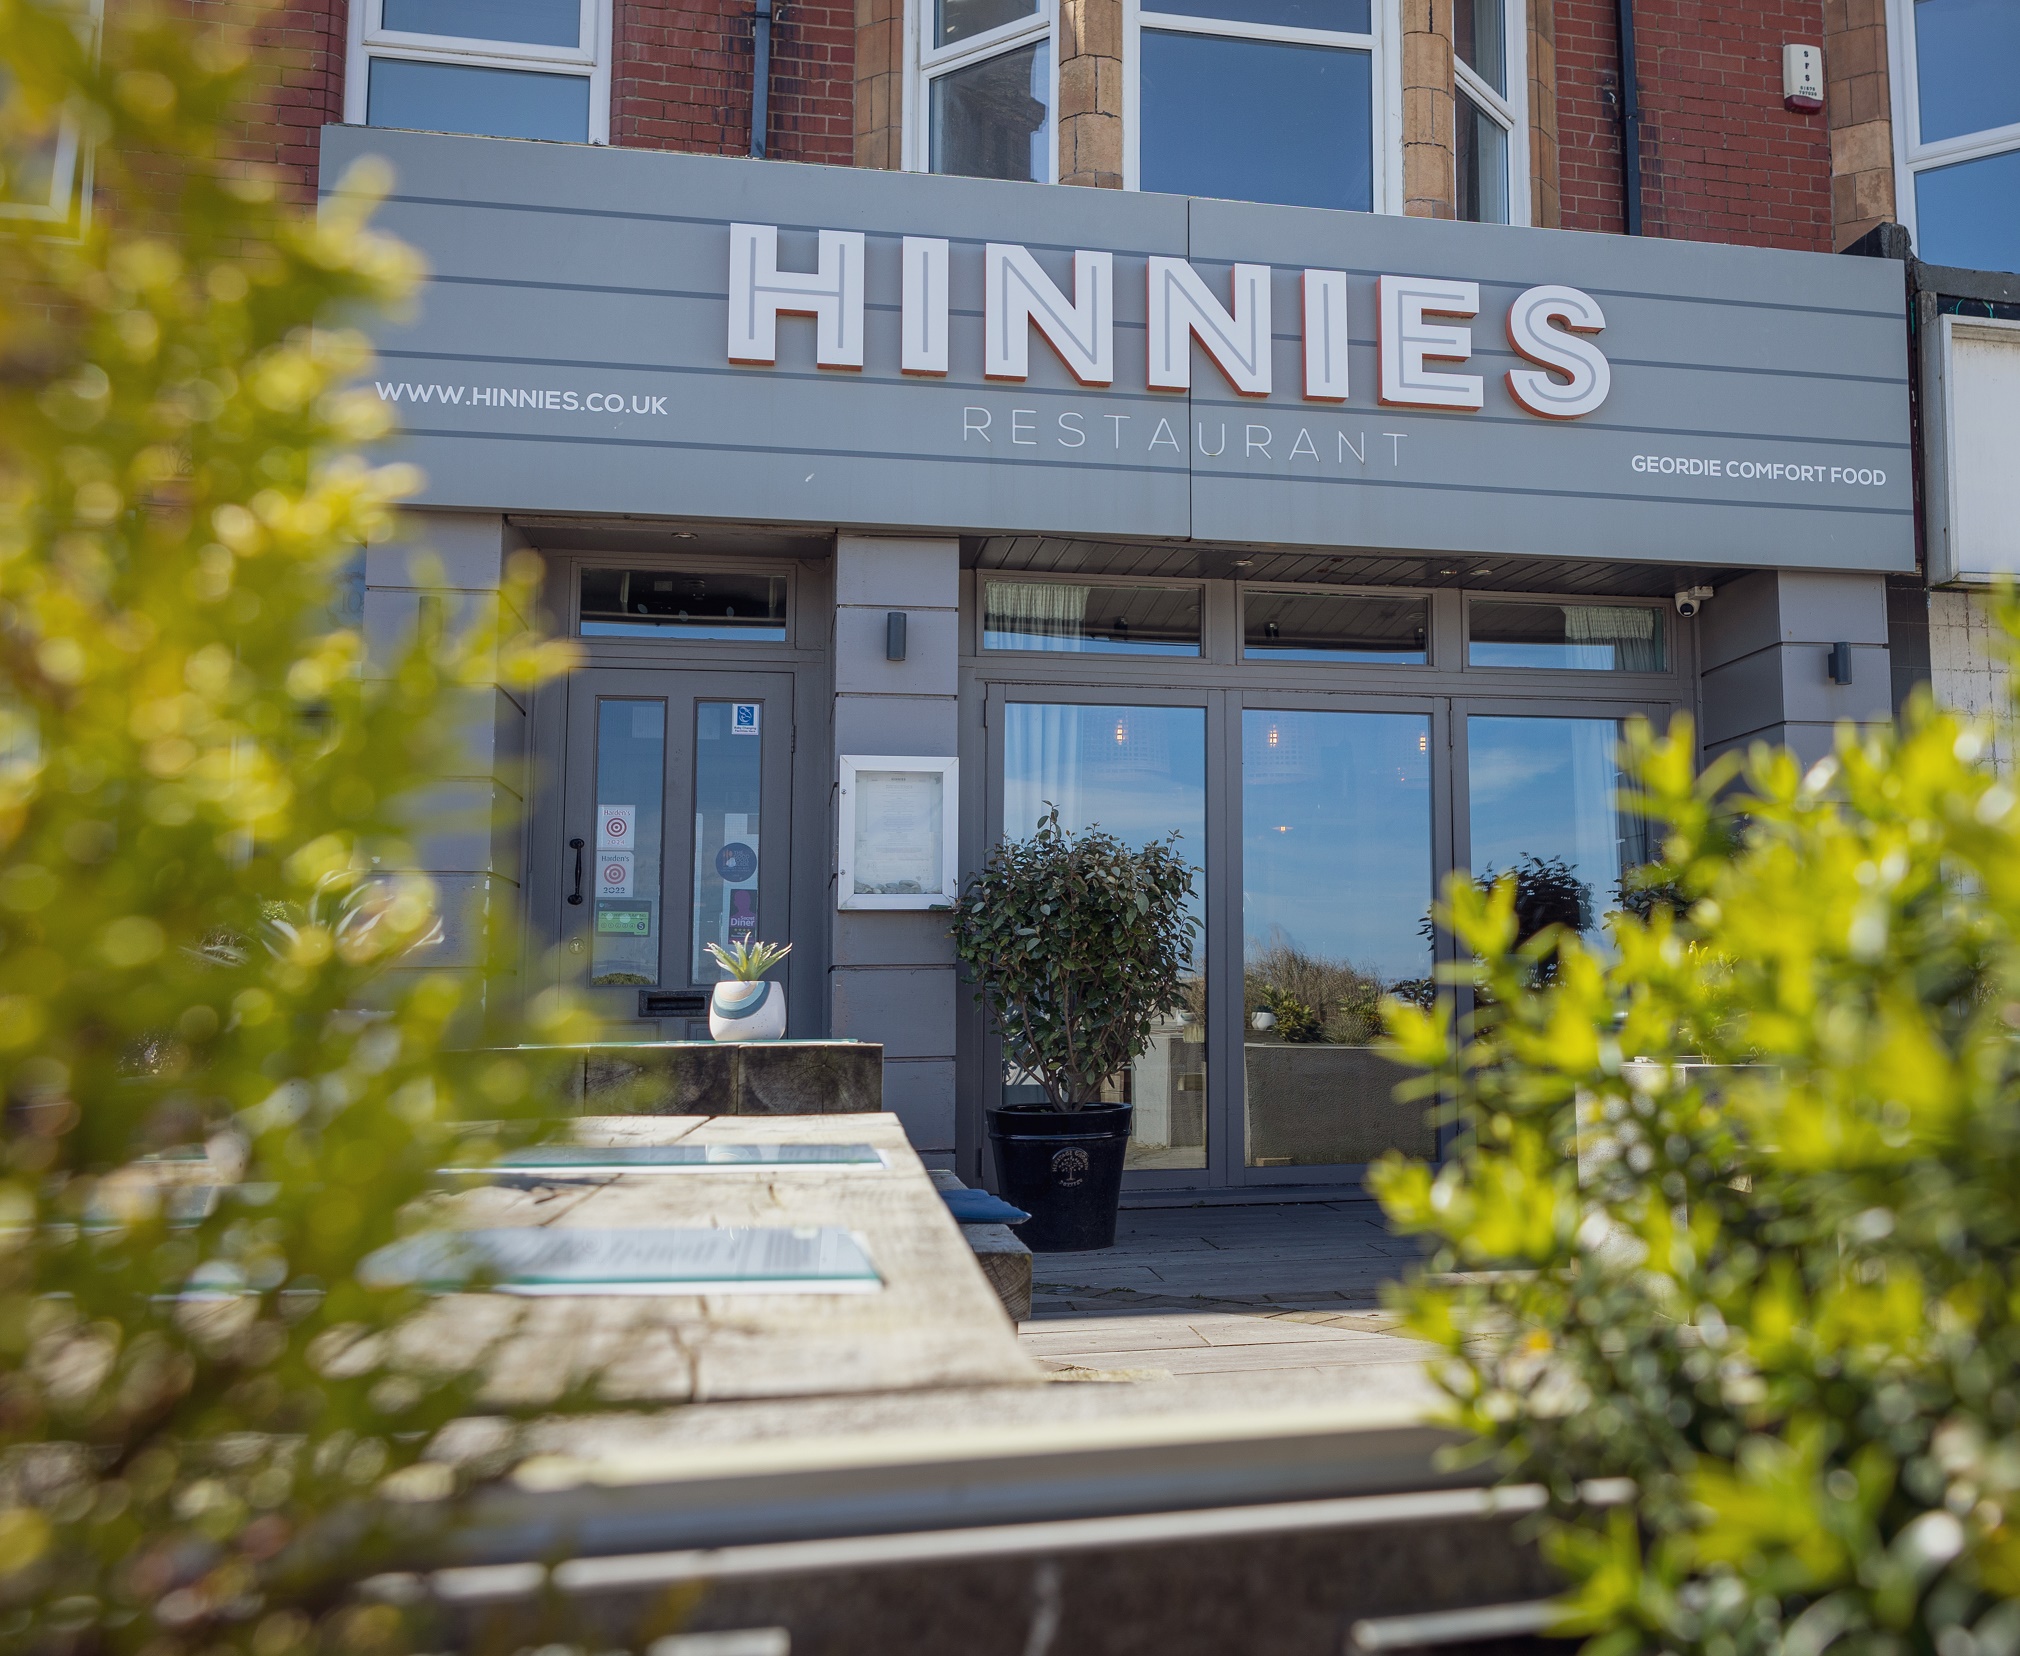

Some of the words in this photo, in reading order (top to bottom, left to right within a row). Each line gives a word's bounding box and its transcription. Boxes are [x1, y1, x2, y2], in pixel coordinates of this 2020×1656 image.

[727, 222, 1611, 419] HINNIES
[375, 381, 668, 415] WWW.HINNIES.CO.UK
[963, 406, 1408, 466] RESTAURANT
[1631, 454, 1722, 478] GEORDIE
[1725, 460, 1827, 483] COMFORT
[1830, 466, 1887, 486] FOOD
[603, 886, 625, 894] 2022
[730, 917, 755, 927] Diner
